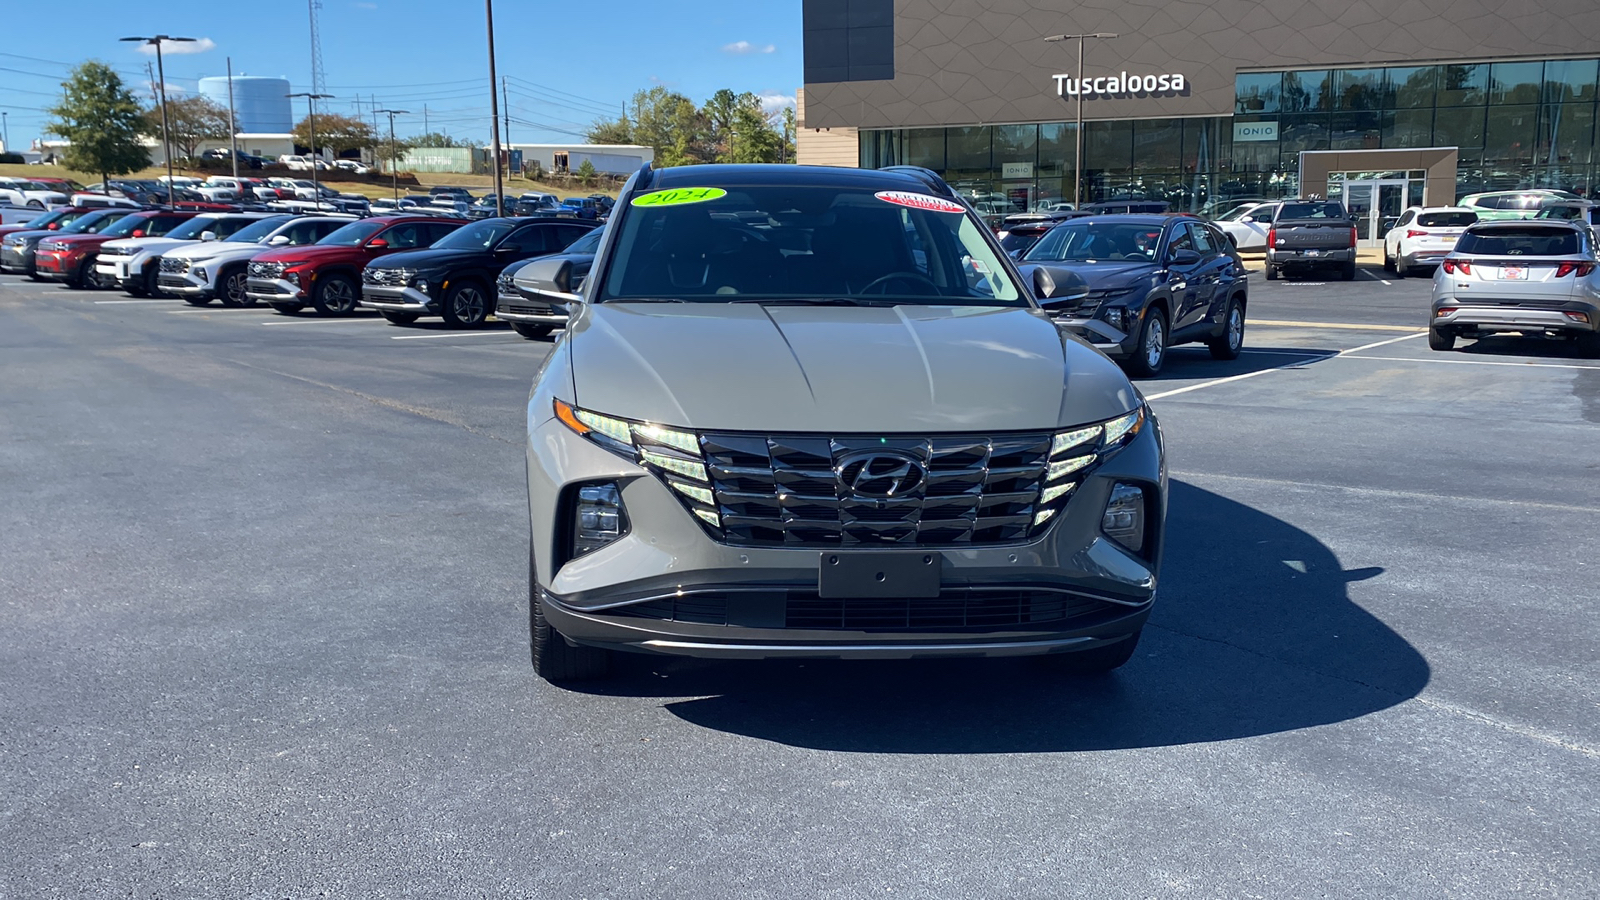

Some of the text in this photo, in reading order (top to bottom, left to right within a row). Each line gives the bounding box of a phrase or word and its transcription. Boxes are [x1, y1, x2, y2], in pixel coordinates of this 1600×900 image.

[1052, 71, 1184, 96] Tuscaloosa
[645, 188, 713, 205] 2024
[885, 192, 955, 207] CERTIFIED
